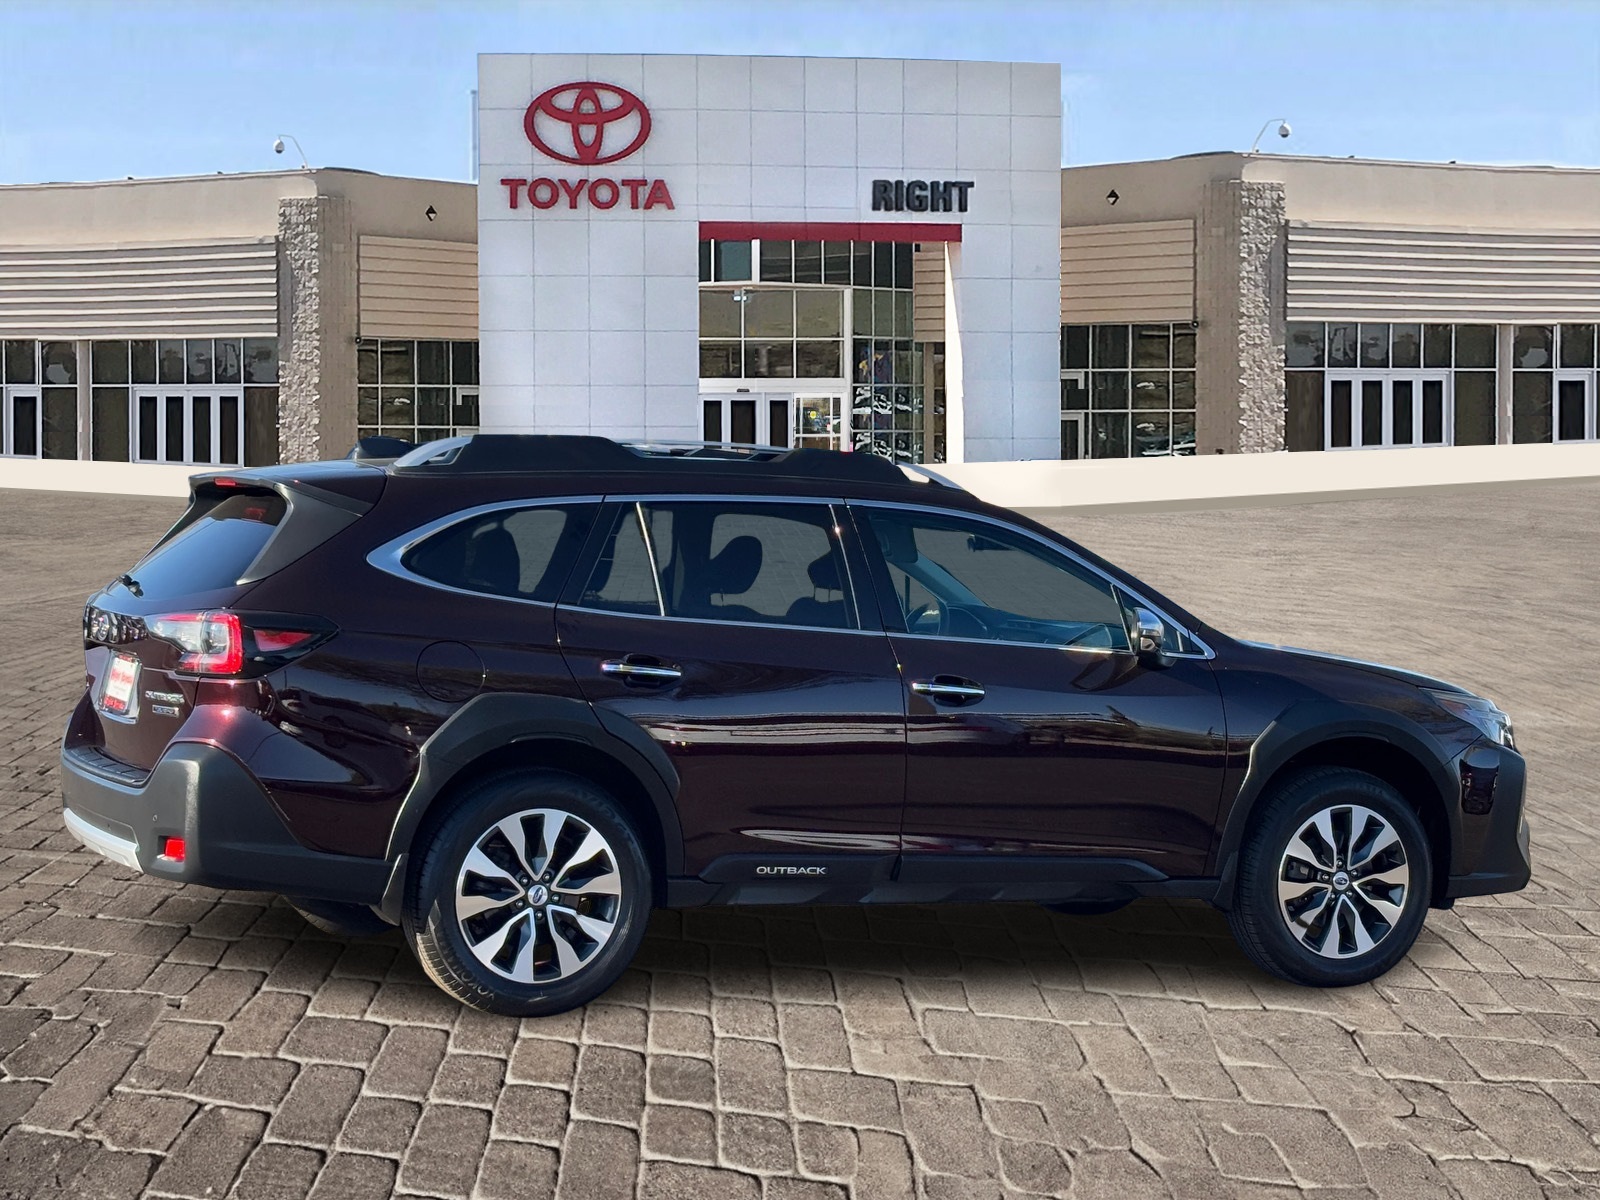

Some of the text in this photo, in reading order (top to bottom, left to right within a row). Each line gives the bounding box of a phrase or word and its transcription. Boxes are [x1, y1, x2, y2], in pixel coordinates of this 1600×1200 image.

[500, 177, 675, 210] TOYOTA
[871, 179, 975, 212] RIGHT
[756, 866, 826, 875] OUTBACK
